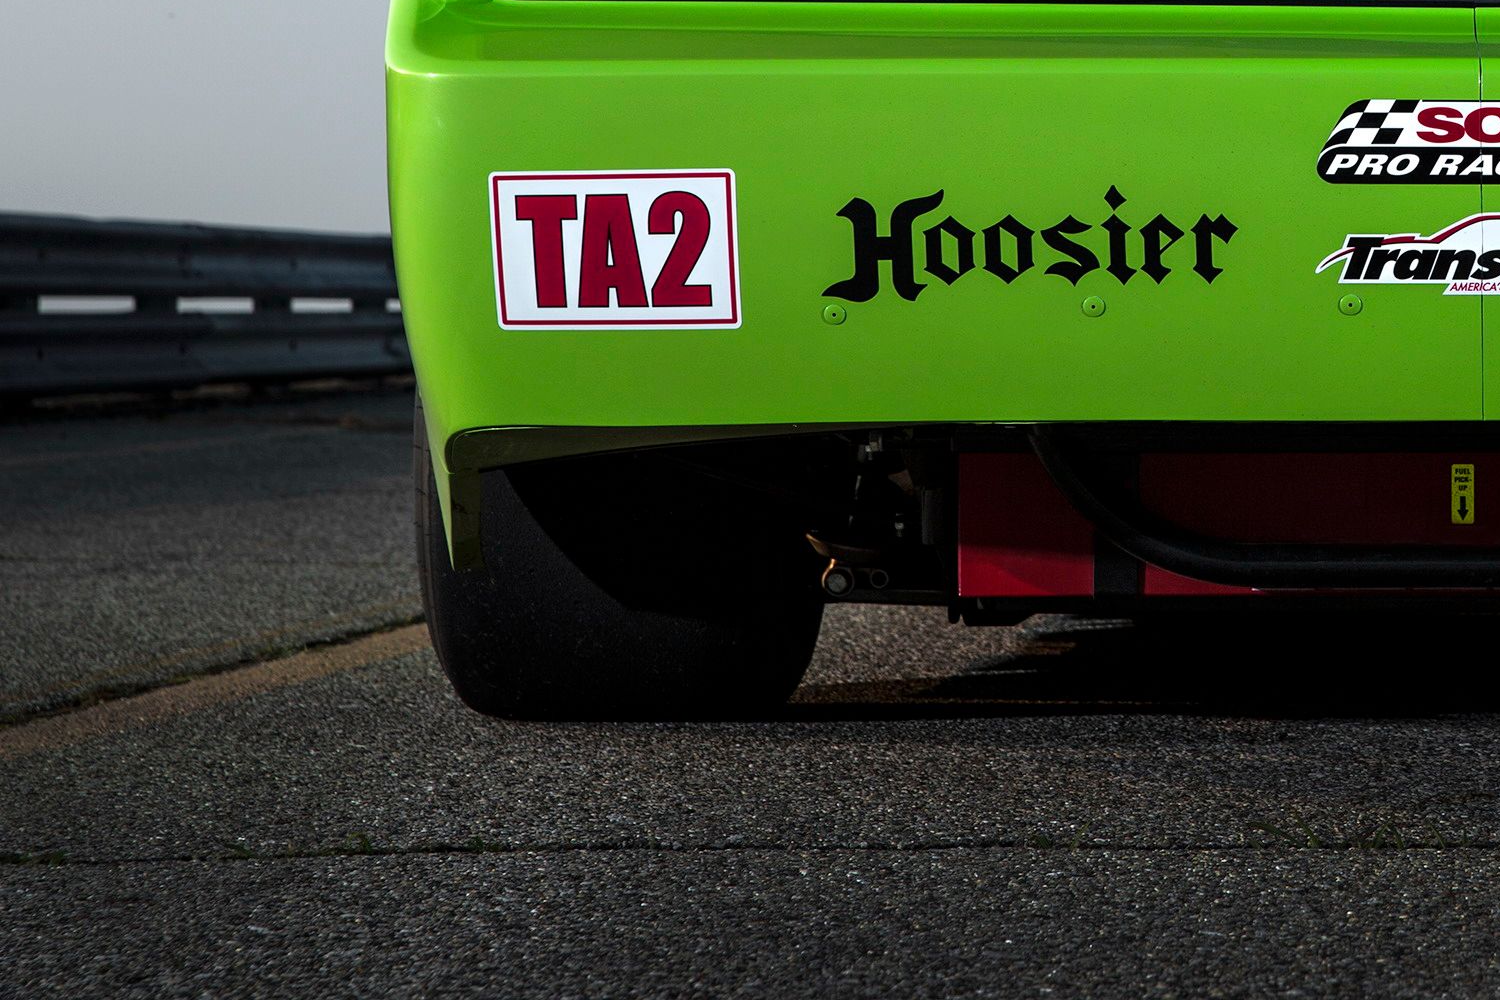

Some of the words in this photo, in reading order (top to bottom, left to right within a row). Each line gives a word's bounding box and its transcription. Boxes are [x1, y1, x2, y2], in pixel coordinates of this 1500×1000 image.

[1325, 153, 1419, 176] PRO
[514, 190, 713, 309] TA2
[821, 185, 1238, 302] Hoosier
